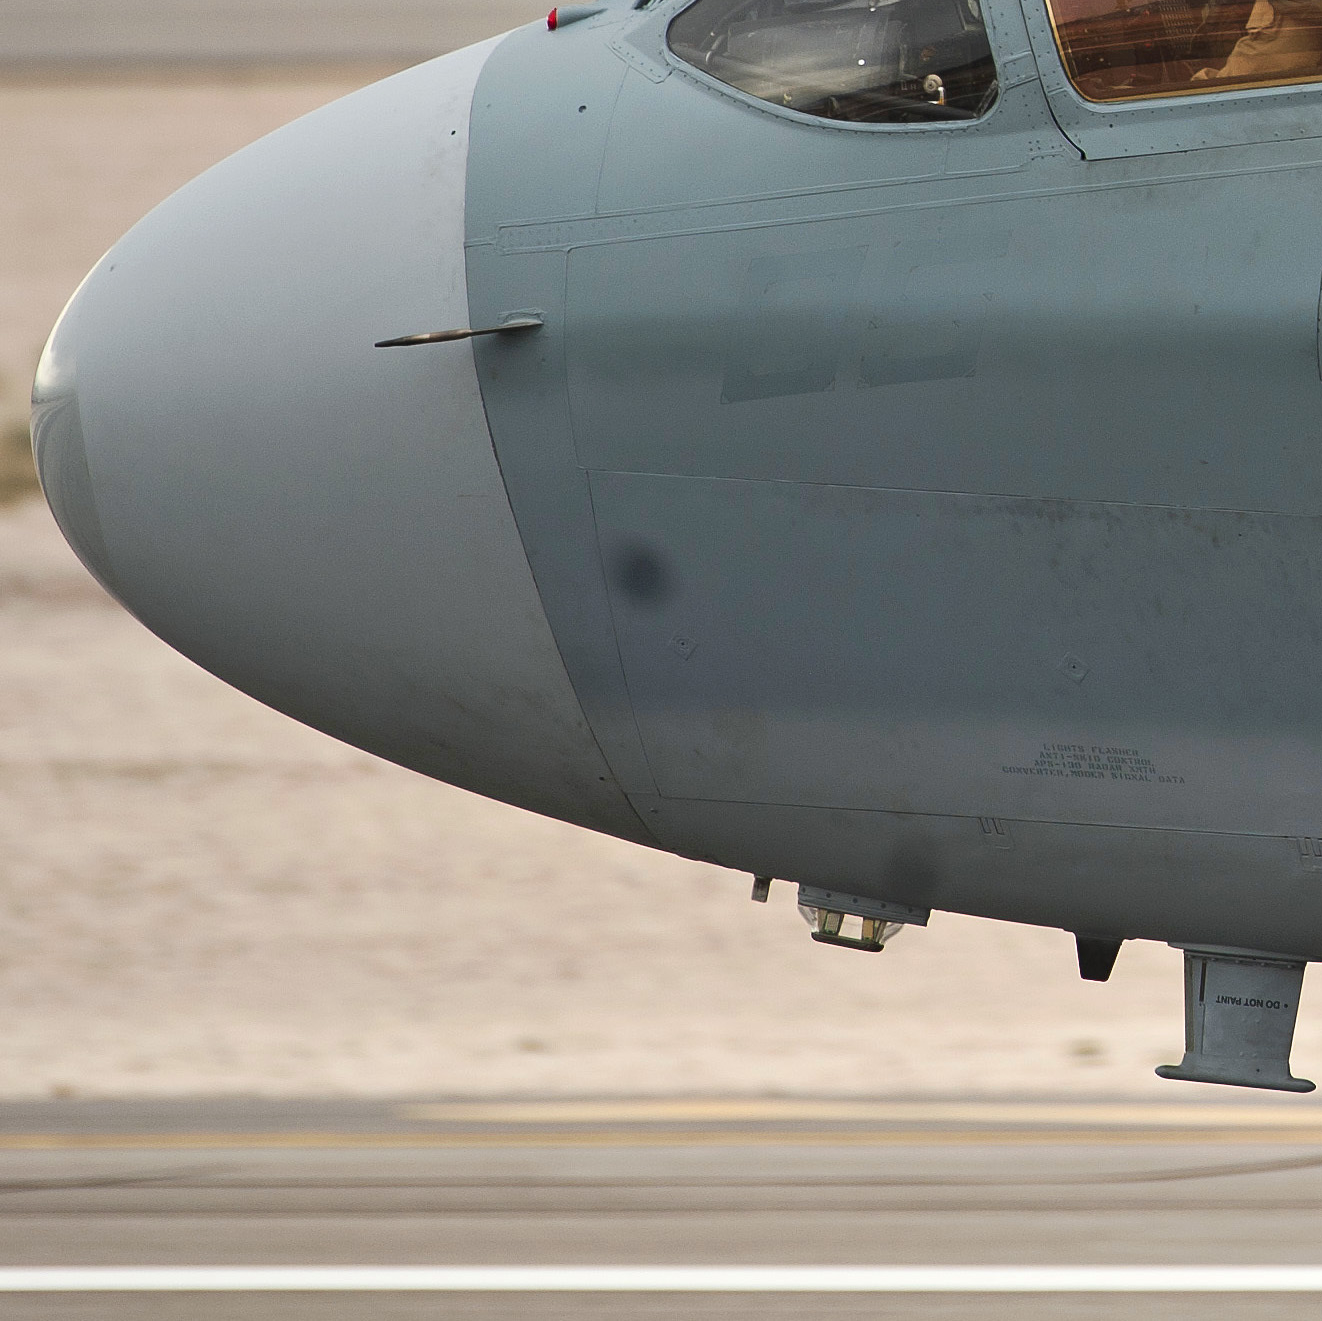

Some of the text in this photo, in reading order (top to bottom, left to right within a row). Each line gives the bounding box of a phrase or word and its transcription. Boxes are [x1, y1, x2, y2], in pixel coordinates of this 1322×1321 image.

[1043, 743, 1139, 756] LIGHTS FLASHER
[1039, 751, 1155, 766] ANTI-SKID CONTROL
[1088, 762, 1122, 772] RADAR
[1111, 772, 1152, 783] SIGNAL
[1158, 776, 1186, 784] DATA
[1215, 994, 1281, 1009] DO NOT PAINT
